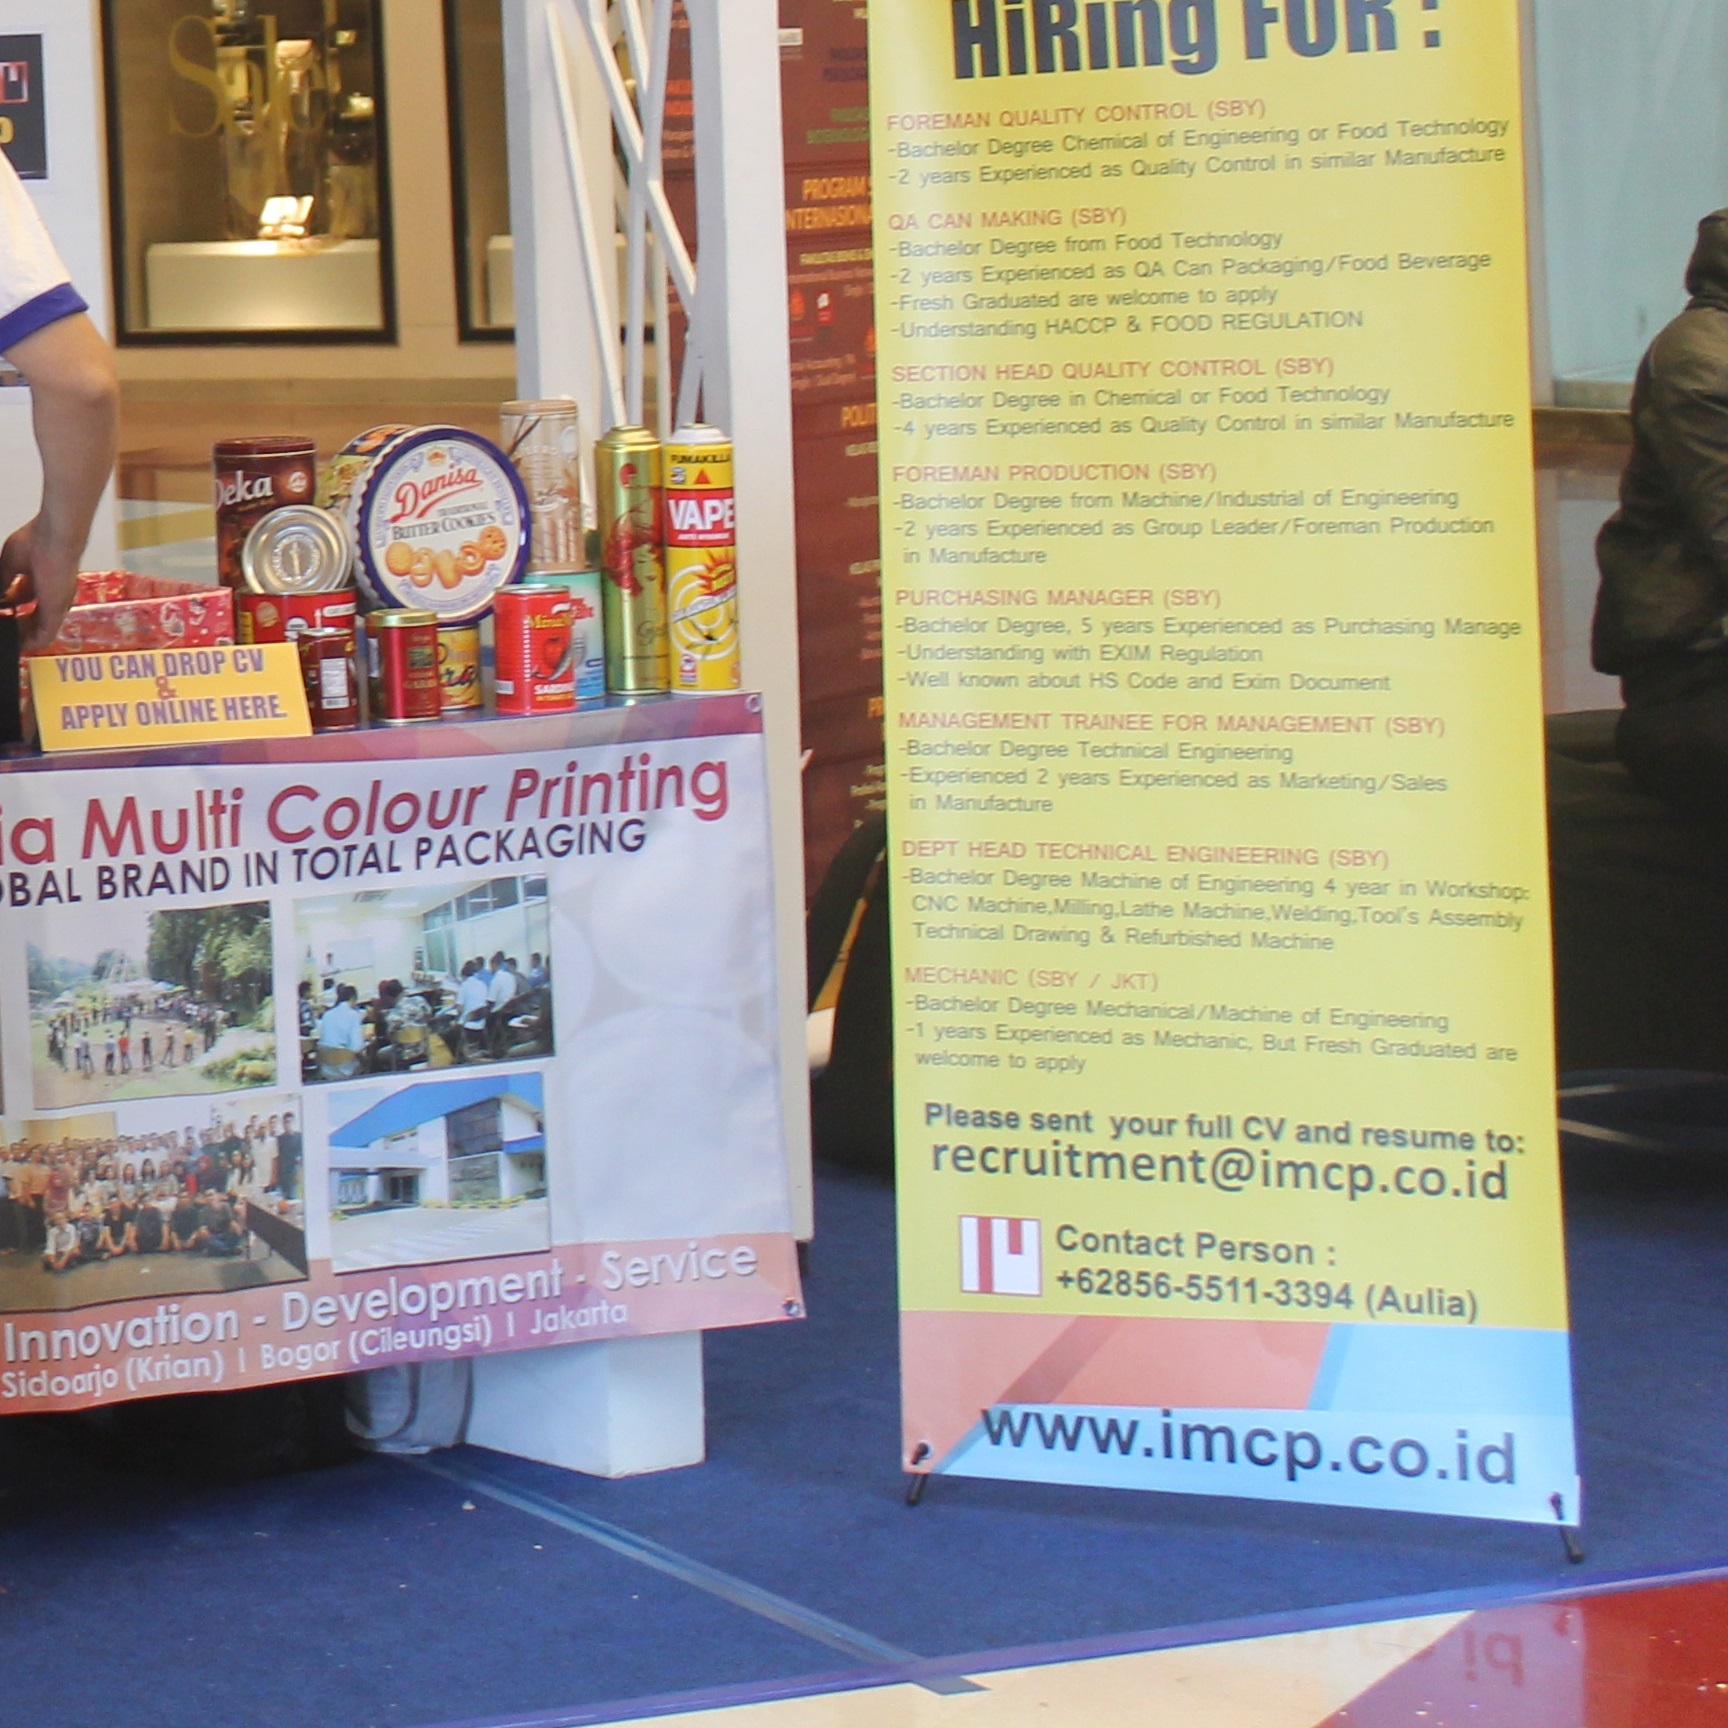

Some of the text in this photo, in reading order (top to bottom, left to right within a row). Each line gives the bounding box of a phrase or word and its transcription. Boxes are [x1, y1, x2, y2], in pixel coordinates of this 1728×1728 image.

[887, 99, 1266, 133] FOREMAN QUALITY CONTROL (SBY)
[987, 138, 1054, 158] Degree
[1061, 132, 1148, 151] Chemical
[1155, 130, 1175, 148] of
[1183, 126, 1299, 149] Engineering
[1308, 128, 1329, 141] or
[1337, 122, 1388, 139] Food
[1396, 118, 1510, 138] Technology
[918, 168, 971, 188] years
[979, 162, 1092, 185] Experienced
[1100, 164, 1123, 177] as
[1130, 158, 1196, 178] Quality
[1205, 154, 1276, 173] Control
[1285, 154, 1302, 169] in
[1311, 151, 1376, 169] similar
[1385, 147, 1507, 165] Manufacture
[887, 214, 919, 231] QA
[928, 210, 974, 229] CAN
[981, 209, 1063, 227] MAKING
[1070, 207, 1127, 228] (SBY)
[891, 357, 1334, 382] SECTION HEAD QUALITY CONTROL (SBY)
[892, 463, 1217, 484] FOREMAN PRODUCTION (SBY)
[391, 465, 482, 523] Danisa
[668, 499, 735, 530] VAPE
[895, 589, 1221, 610] PURCHASING MANAGER (SBY)
[55, 648, 263, 682] YOU CAN DROP CV
[155, 675, 176, 699] &
[61, 703, 128, 730] APPLY
[136, 698, 218, 726] ONLINE
[897, 712, 1445, 738] MANAGEMENT TRAINEE FOR MANAGEMENT (SBY)
[81, 790, 243, 861] Multi
[267, 780, 488, 845] Colour
[506, 753, 730, 824] Printing
[97, 859, 231, 900] BRAND
[244, 854, 279, 891] IN
[293, 846, 403, 884] TOTAL
[416, 818, 648, 872] PACKAGING
[901, 840, 1389, 871] DEPT HEAD TECHNICAL ENGINEERING (SBY)
[904, 967, 1158, 992] MECHANIC (SBY JKT)
[924, 1102, 1526, 1156] Please sent your full CV and resume to:
[932, 1139, 1508, 1201] recruitment@imcp.co.id
[1054, 1224, 1315, 1265] Contact Person
[3, 1240, 757, 1364] Innovation Development Service
[1054, 1267, 1479, 1325] +62856-5511-3394 (Aulia)
[2, 1301, 627, 1401] Sidoarjo (Krian) Bogor (Cileungsi) Jakarta
[981, 1407, 1516, 1485] www.imcp.co.id
